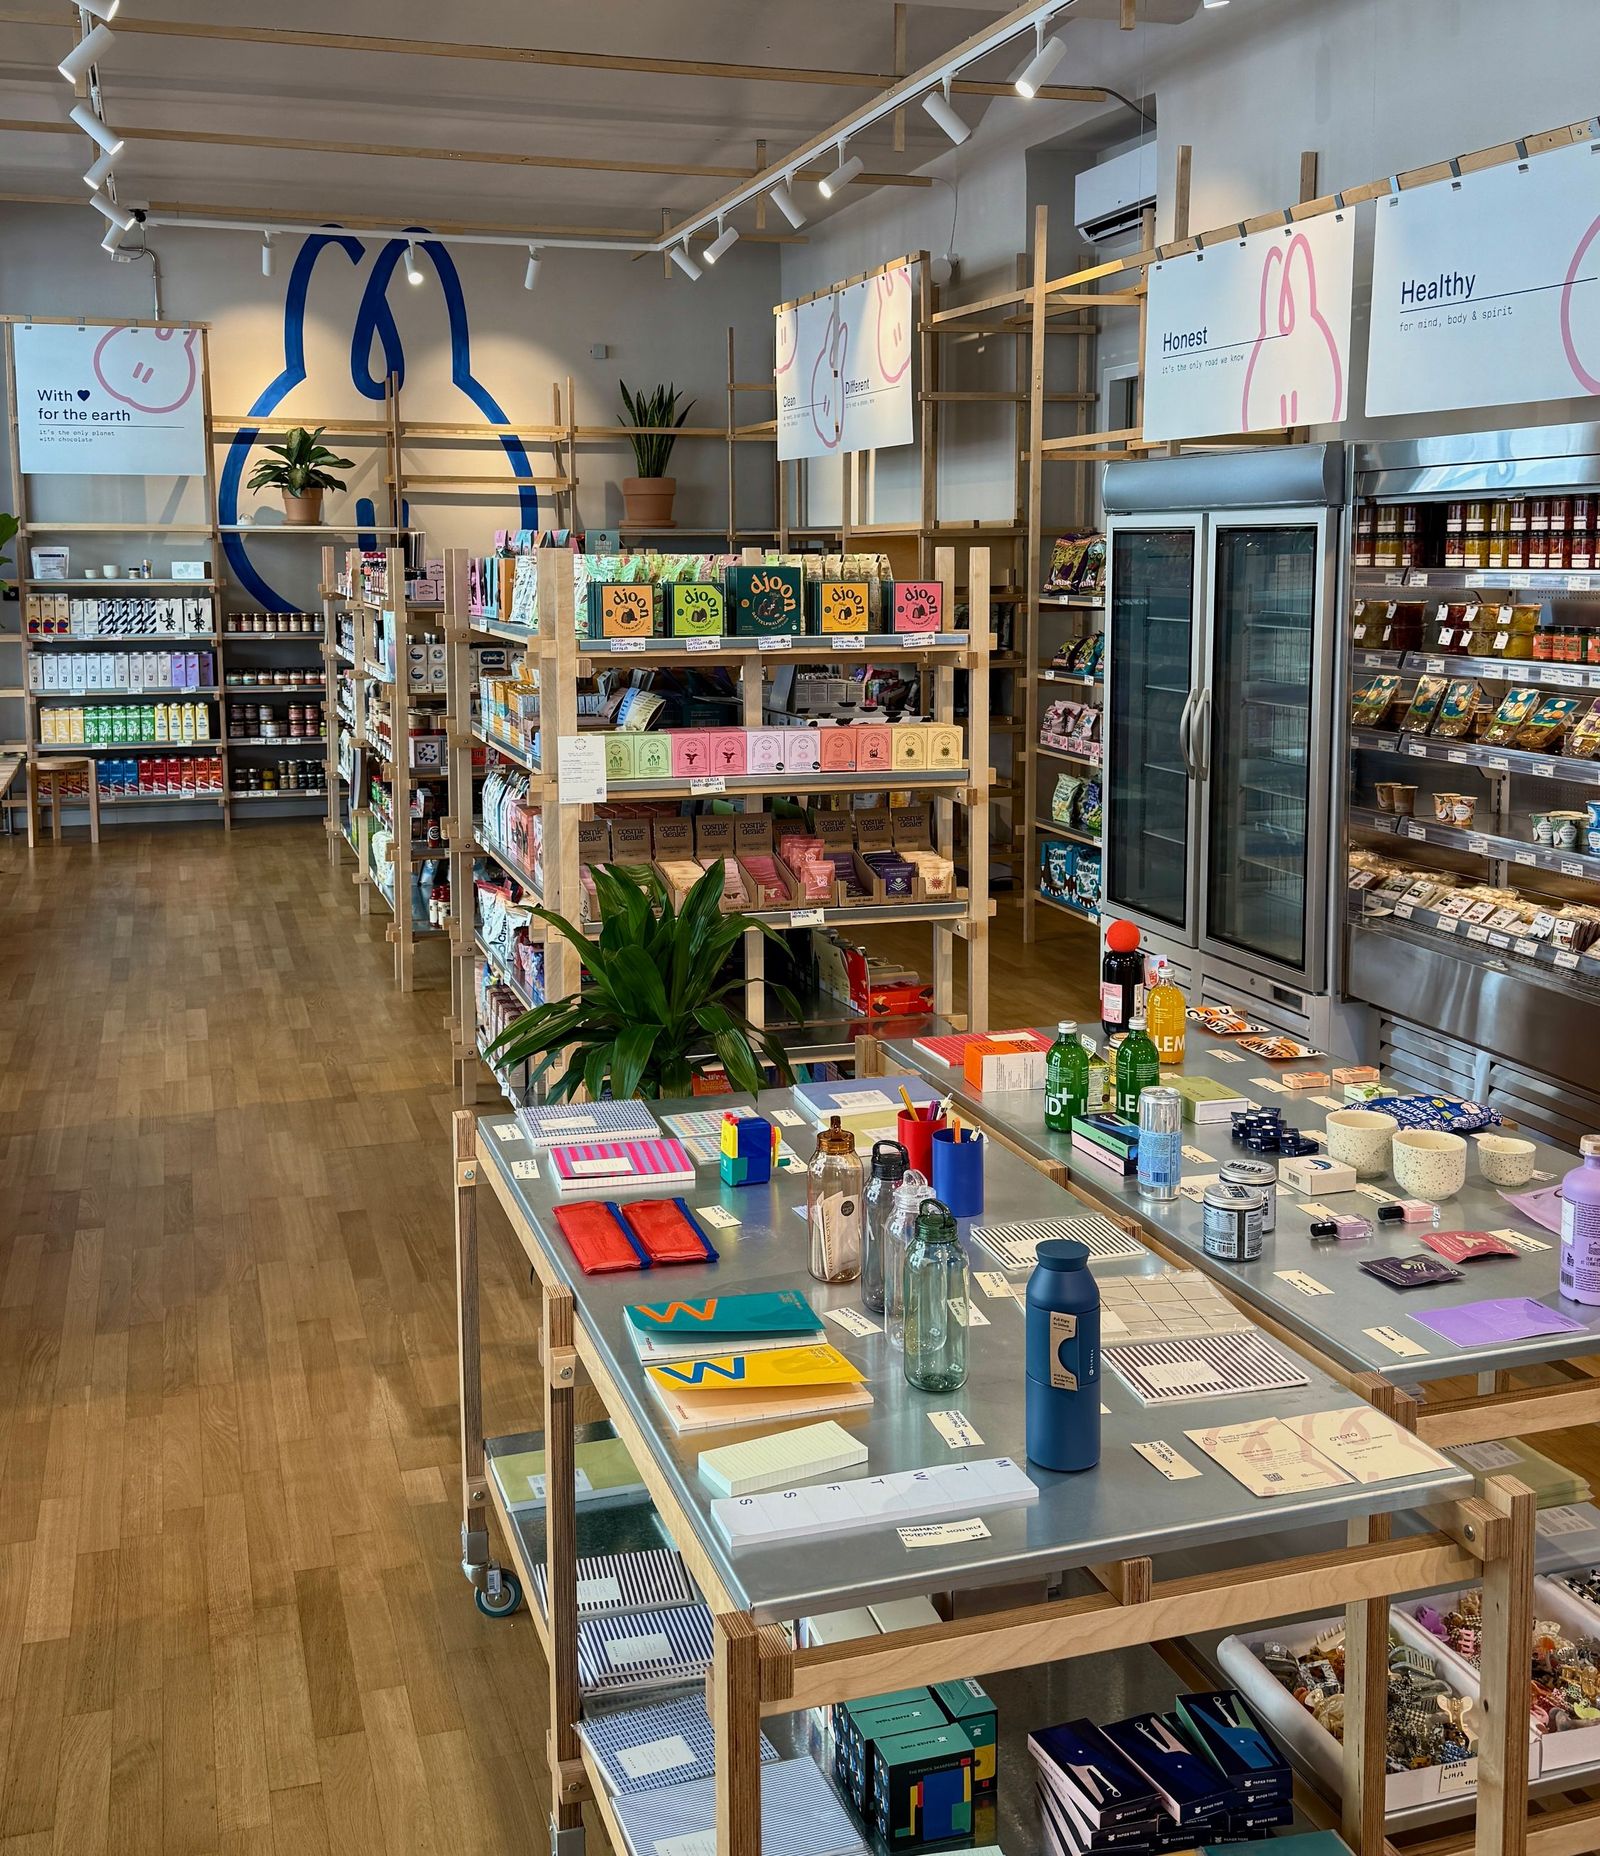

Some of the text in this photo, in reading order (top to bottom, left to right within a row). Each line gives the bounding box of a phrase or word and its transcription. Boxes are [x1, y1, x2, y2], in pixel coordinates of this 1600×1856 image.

[1401, 271, 1476, 304] Healthy
[1400, 321, 1414, 332] for
[1417, 317, 1442, 329] mind,
[1447, 313, 1468, 324] body
[1482, 306, 1513, 320] spirit
[1163, 326, 1208, 352] Honest
[1204, 358, 1218, 367] road
[845, 379, 870, 394] Different
[37, 389, 73, 402] With
[38, 408, 131, 421] for the earth
[750, 571, 797, 612] djoon
[613, 588, 649, 619] djoon
[684, 588, 720, 618] djoon
[832, 586, 865, 616] djoon
[904, 586, 938, 616] djoon
[819, 819, 846, 828] cosmic
[860, 818, 886, 826] cosmic
[898, 814, 925, 824] cosmic
[900, 820, 924, 828] dealer
[659, 824, 688, 832] cosmic
[702, 822, 730, 832] cosmic
[740, 820, 768, 830] cosmic
[579, 828, 604, 836] osmic
[618, 827, 646, 836] cosmic
[662, 829, 688, 838] dealer
[704, 828, 728, 836] dealer
[742, 826, 767, 835] dealer
[620, 833, 644, 842] dealer
[1118, 1091, 1140, 1113] LE
[1411, 1100, 1441, 1120] Chips
[995, 1459, 1012, 1468] M
[955, 1465, 969, 1473] T
[912, 1472, 929, 1482] W
[870, 1478, 885, 1487] T
[784, 1492, 797, 1500] S
[946, 1524, 982, 1534] MONTHLY
[934, 1762, 959, 1770] SHARPENER
